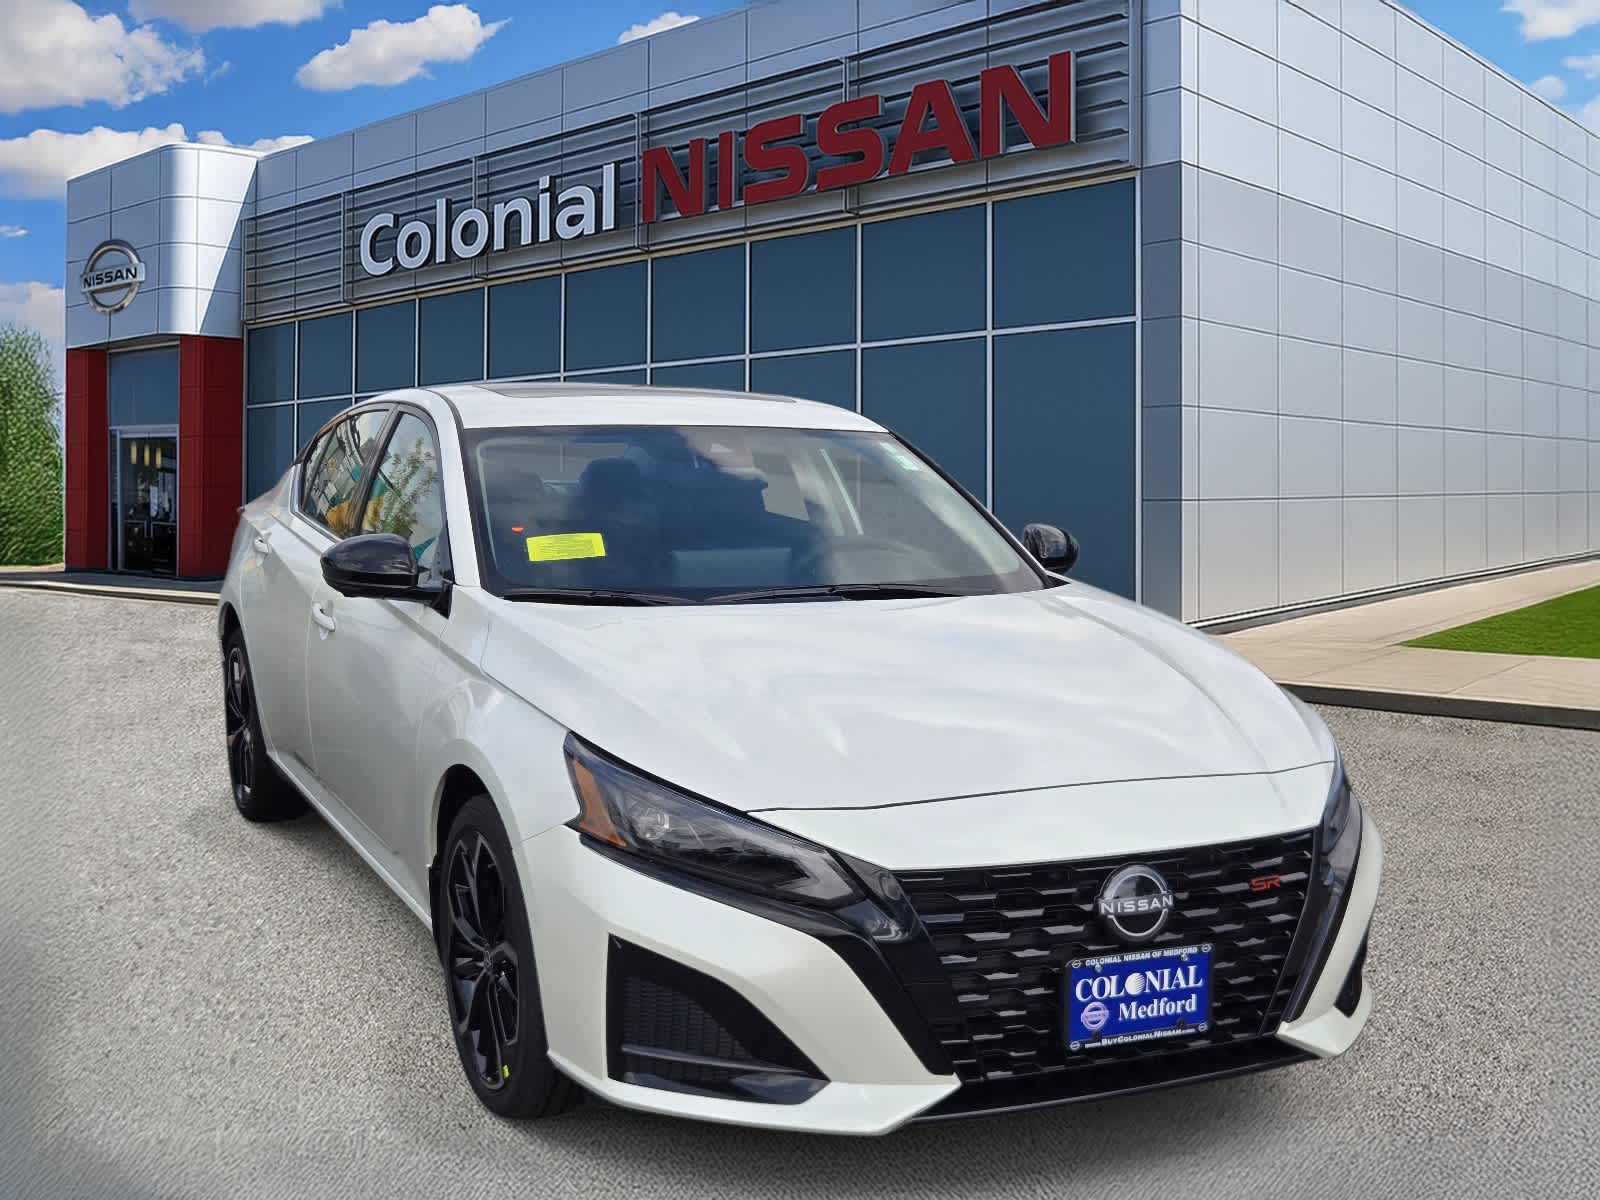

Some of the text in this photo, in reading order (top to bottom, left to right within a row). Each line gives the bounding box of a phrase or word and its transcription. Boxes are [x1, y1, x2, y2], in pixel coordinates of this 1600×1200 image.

[359, 50, 1077, 277] Colonial NISSAN
[83, 266, 138, 289] NISSAN
[1251, 874, 1281, 891] SR
[1101, 894, 1174, 915] NISSAN
[1085, 955, 1122, 968] COLONIAL
[1123, 951, 1151, 962] NISSAN
[1152, 949, 1163, 958] OF
[1075, 965, 1203, 1002] COLONIAL
[1119, 994, 1197, 1021] Medford
